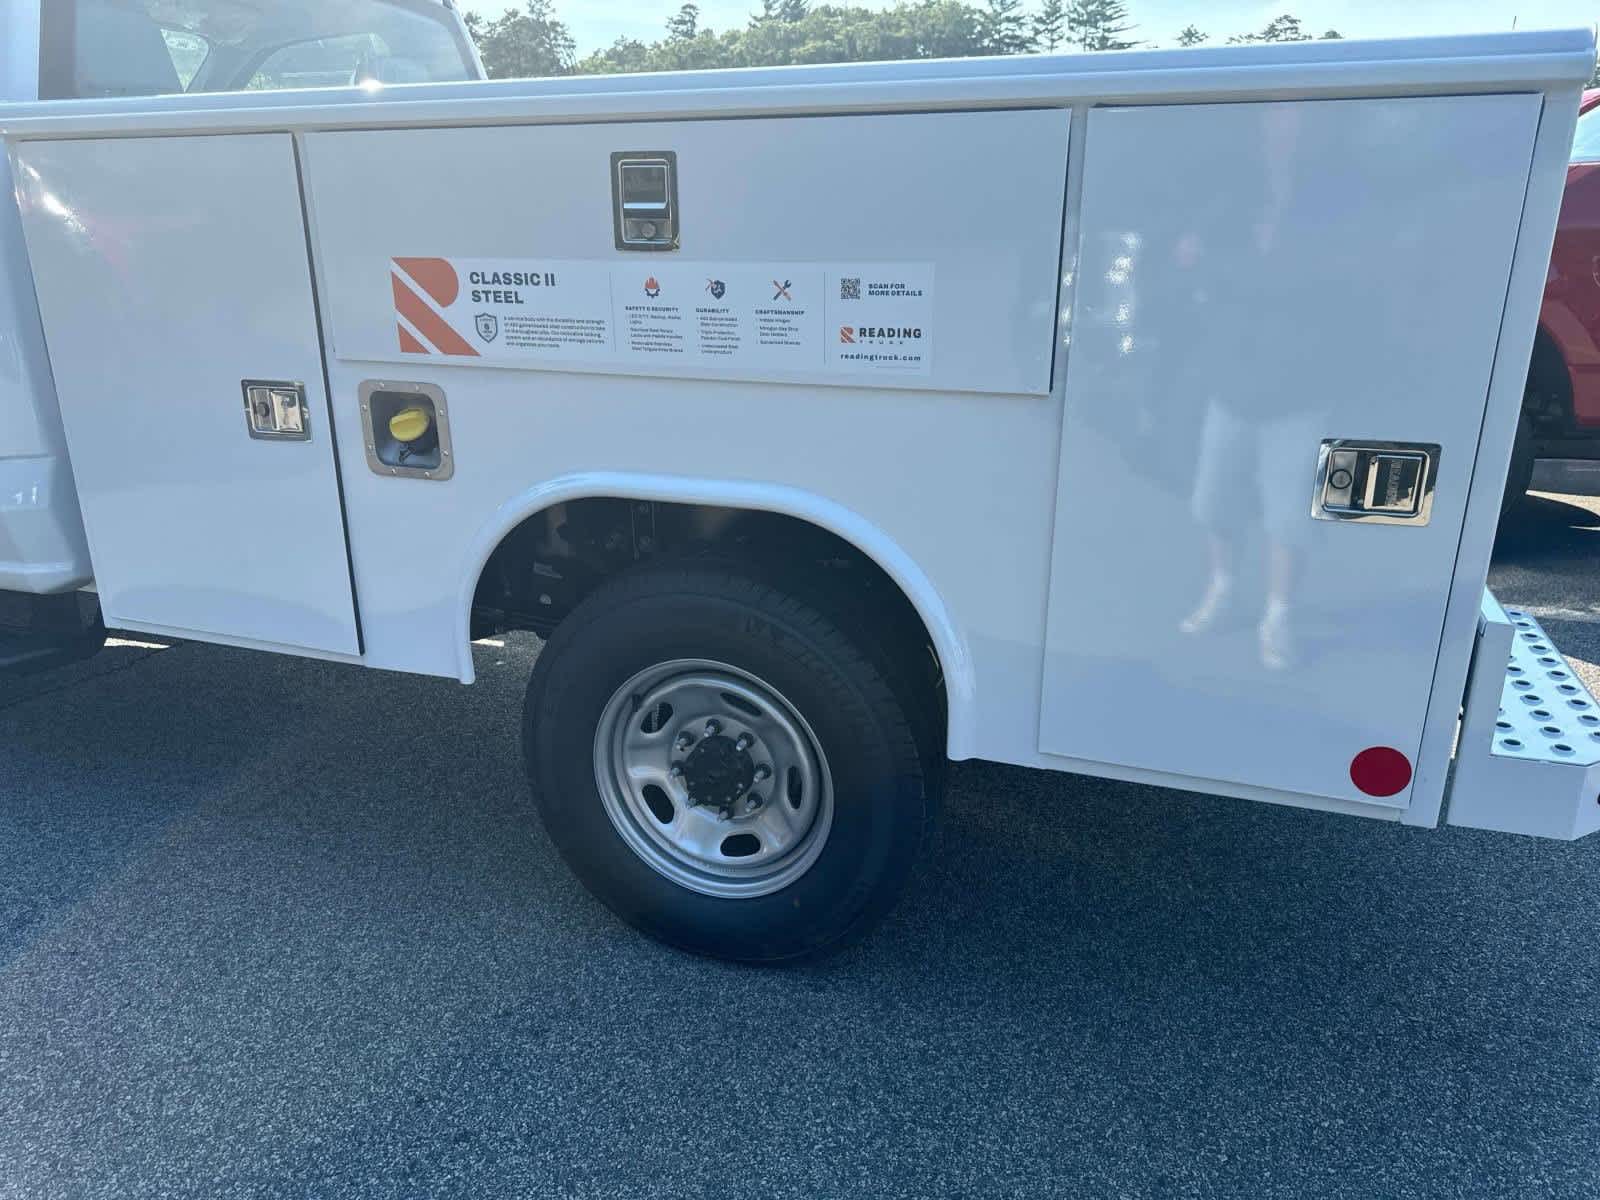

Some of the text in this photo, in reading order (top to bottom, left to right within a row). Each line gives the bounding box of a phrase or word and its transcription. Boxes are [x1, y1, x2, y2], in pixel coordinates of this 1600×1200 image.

[469, 271, 556, 287] CLASSIC II
[471, 290, 524, 304] STEEL
[859, 327, 922, 338] READING
[840, 353, 921, 361] readingtruck.com
